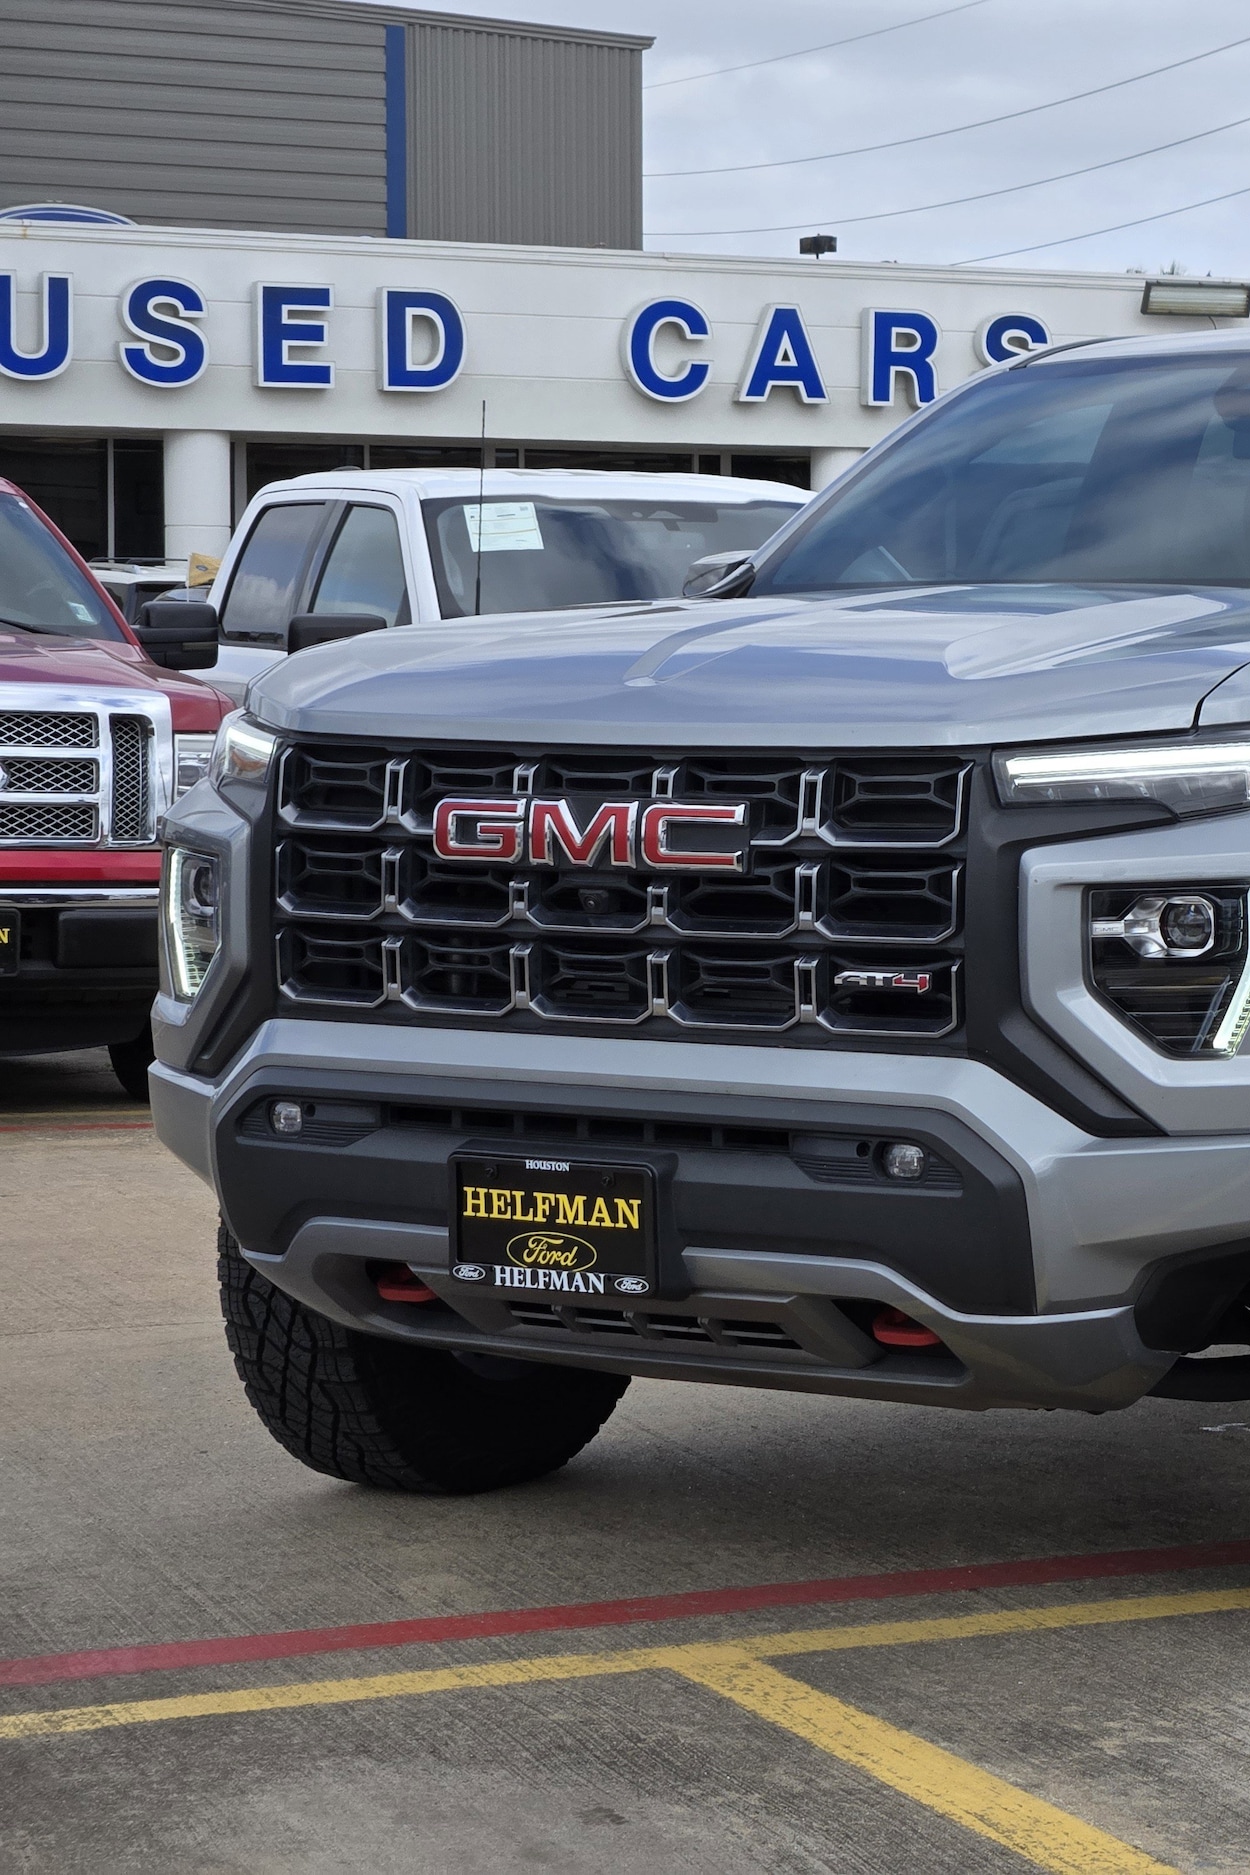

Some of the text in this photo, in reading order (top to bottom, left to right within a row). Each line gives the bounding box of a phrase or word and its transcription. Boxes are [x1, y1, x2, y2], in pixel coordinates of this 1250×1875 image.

[0, 269, 467, 391] USED
[433, 798, 745, 872] GMC
[834, 970, 931, 994] AT4
[525, 1159, 570, 1172] HOUSTON
[463, 1186, 642, 1230] HELFMAN
[522, 1235, 578, 1267] Ford
[493, 1265, 606, 1294] HELFMAN
